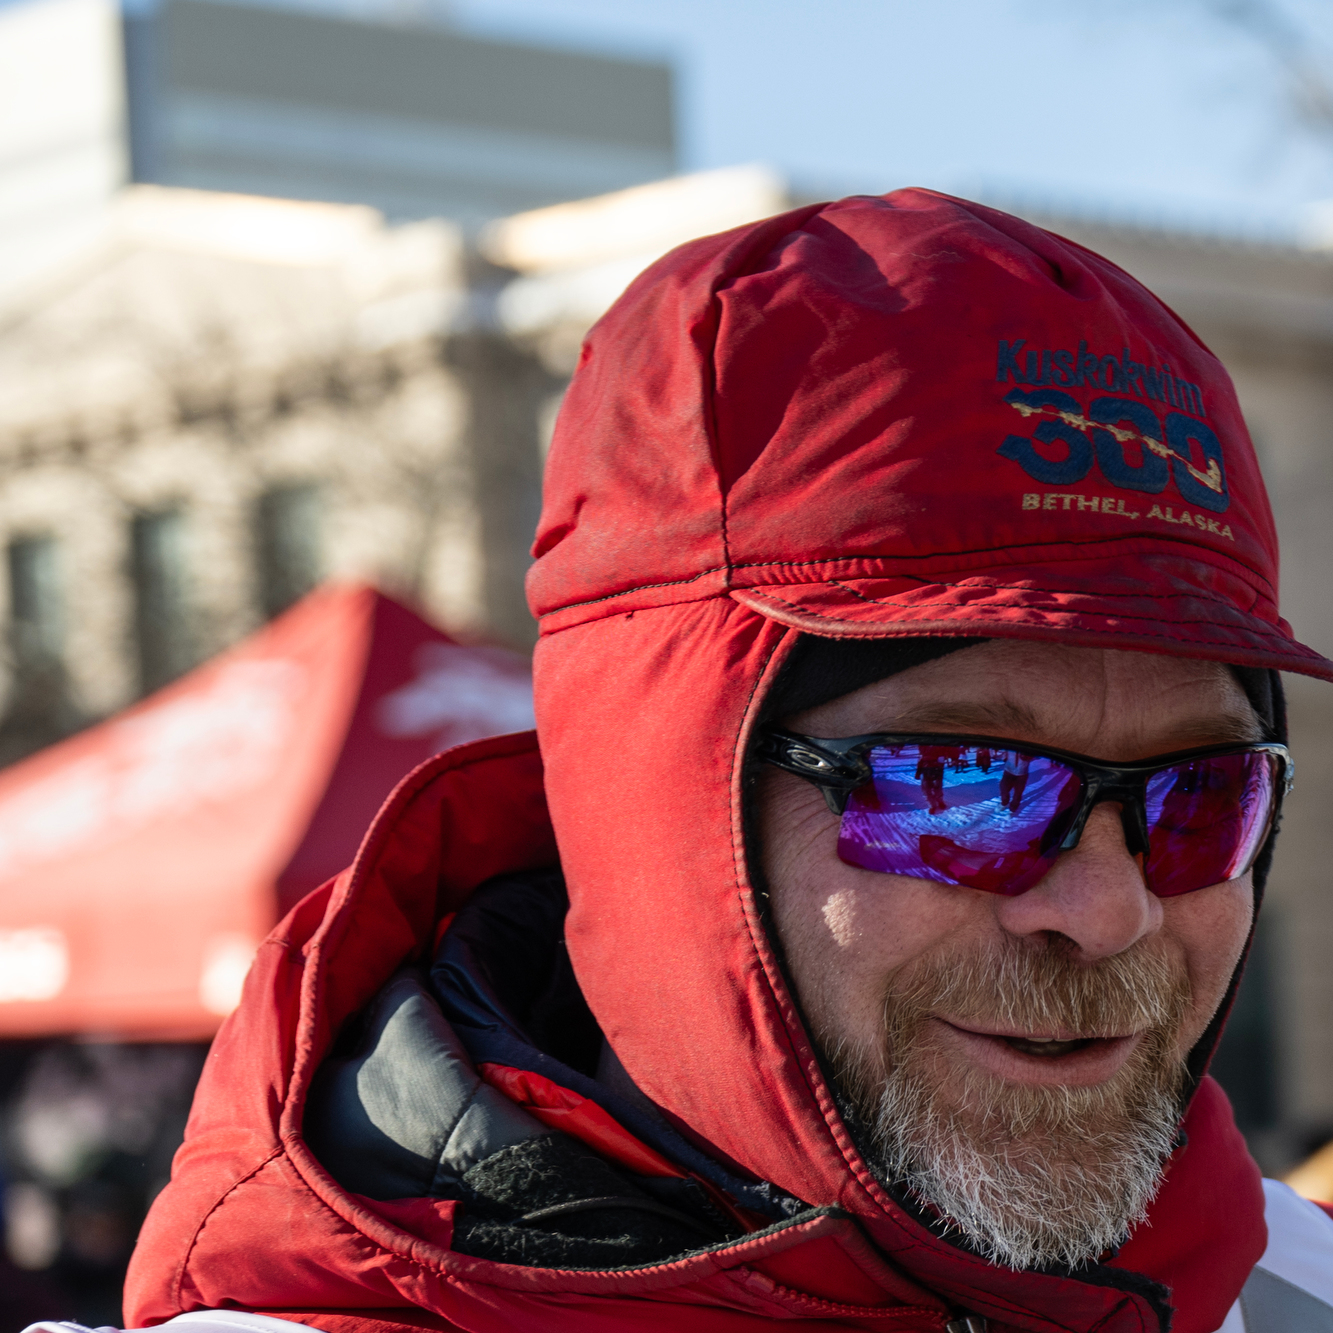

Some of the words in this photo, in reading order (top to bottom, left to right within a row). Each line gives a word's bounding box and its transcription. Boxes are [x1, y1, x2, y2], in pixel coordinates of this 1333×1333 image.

[995, 338, 1206, 418] Kuskokwim
[996, 387, 1231, 514] 300
[1022, 493, 1140, 520] BETHEL,
[1146, 504, 1236, 542] ALASKA
